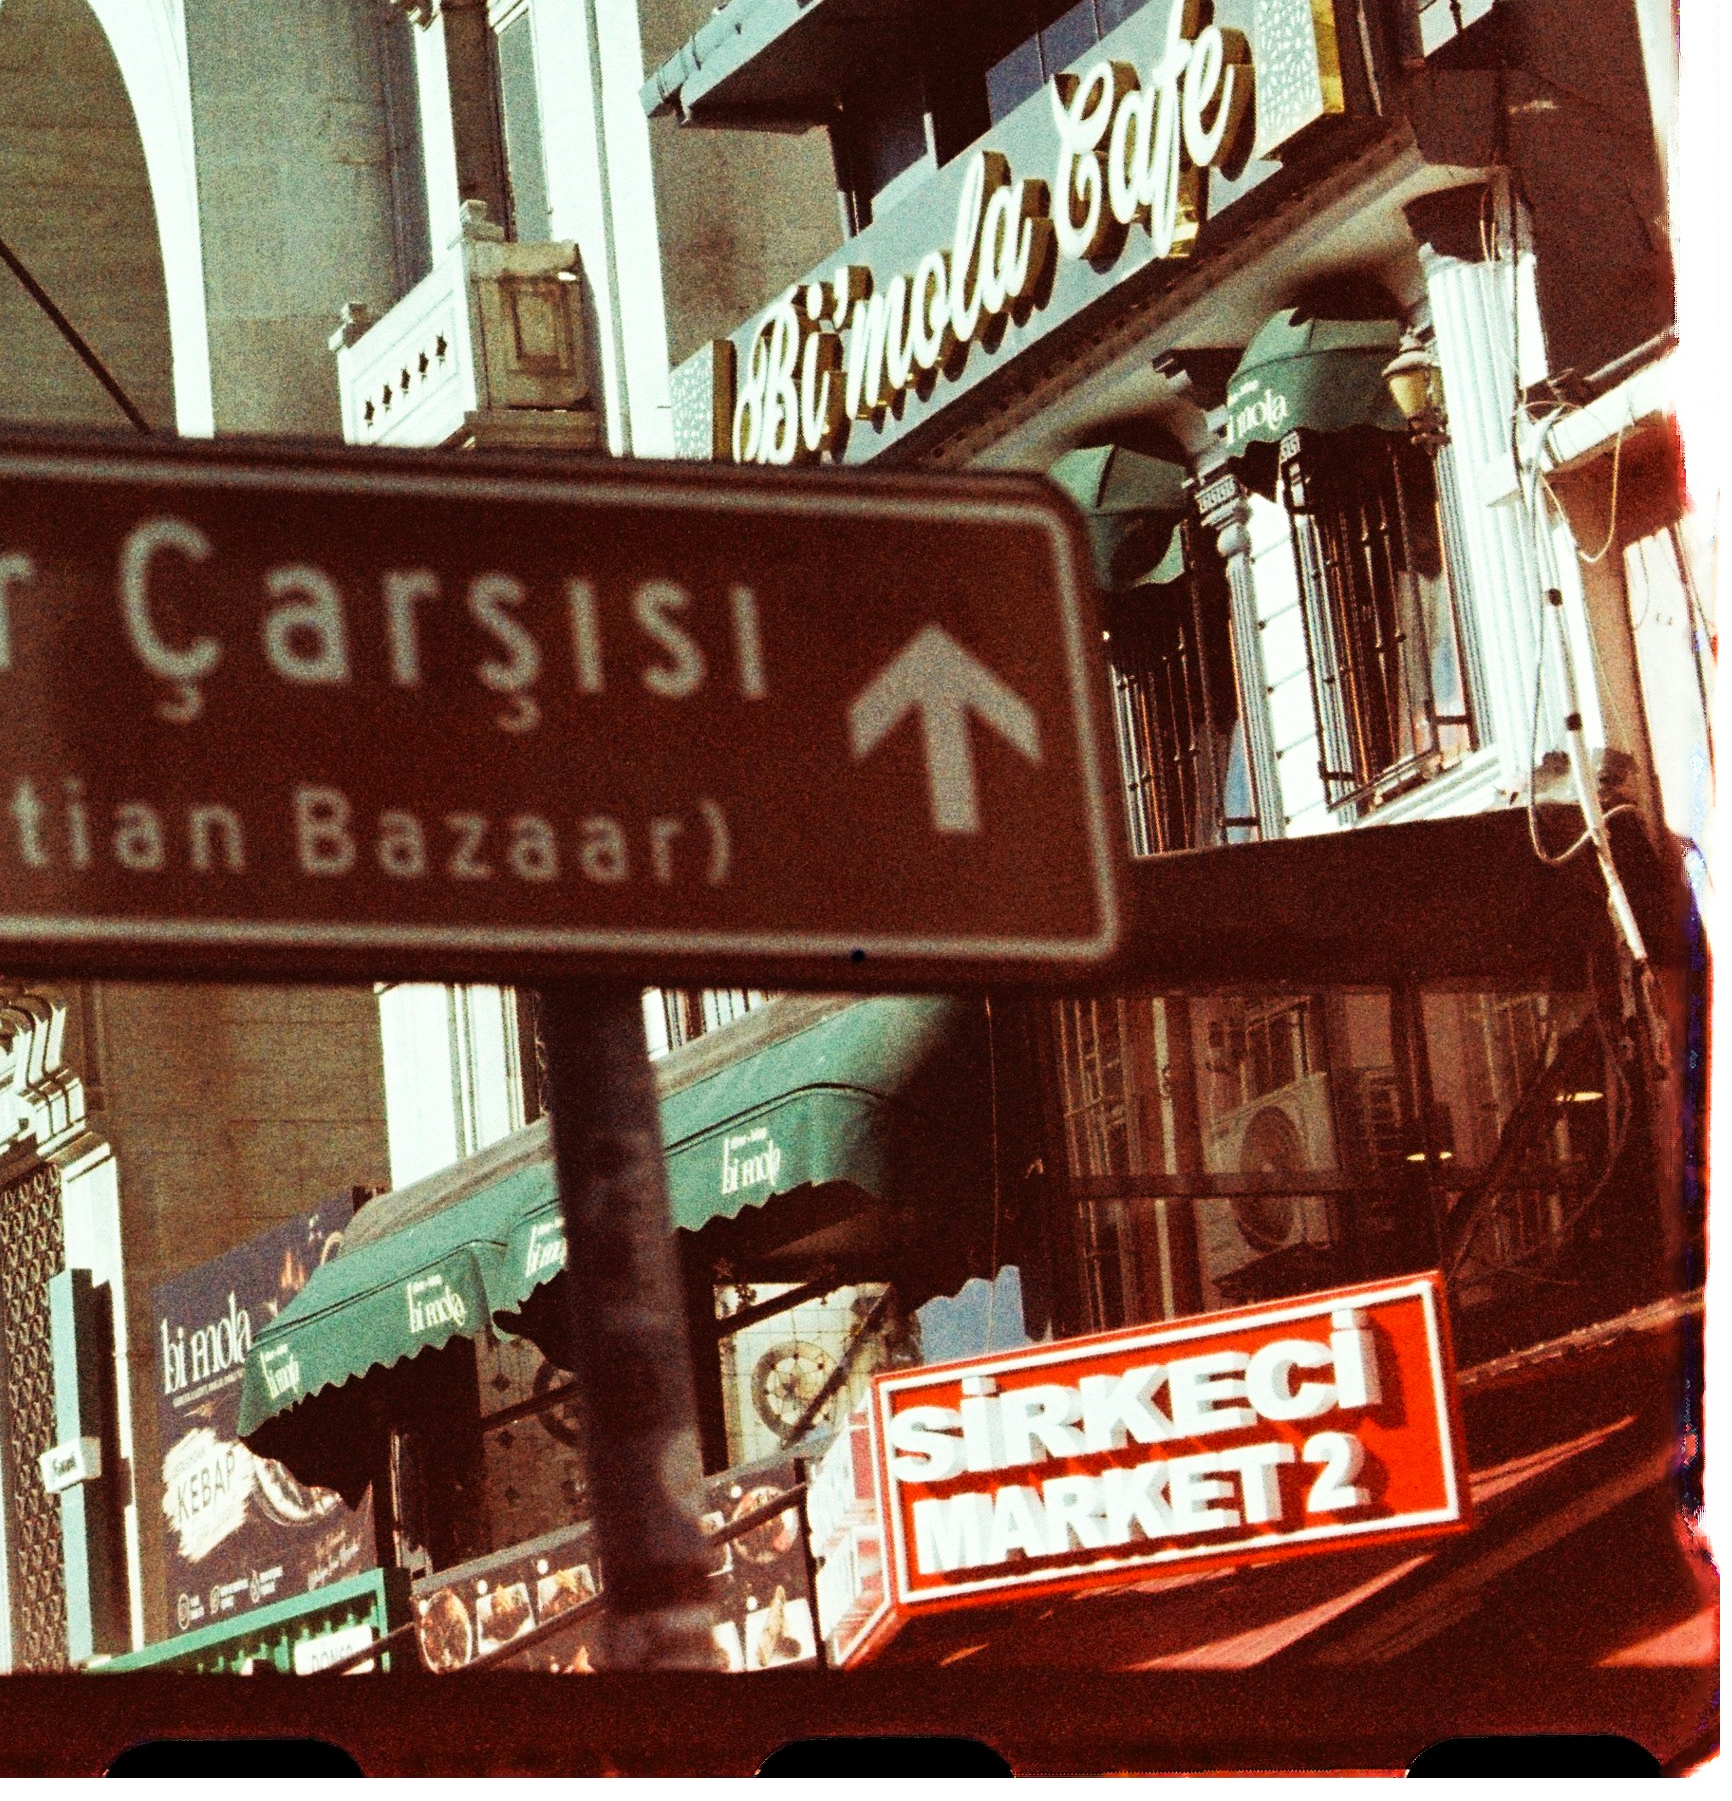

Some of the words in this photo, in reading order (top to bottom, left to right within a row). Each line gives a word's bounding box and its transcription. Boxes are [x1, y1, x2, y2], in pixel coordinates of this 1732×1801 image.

[120, 514, 772, 735] Çarşısı
[293, 783, 734, 886] Bazaar)
[161, 1317, 187, 1396] bi
[190, 1290, 252, 1383] mola
[889, 1307, 1382, 1484] SİRKECİ
[176, 1449, 236, 1523] KEBAP
[912, 1440, 1295, 1577] MARKET
[1302, 1430, 1372, 1514] 2
